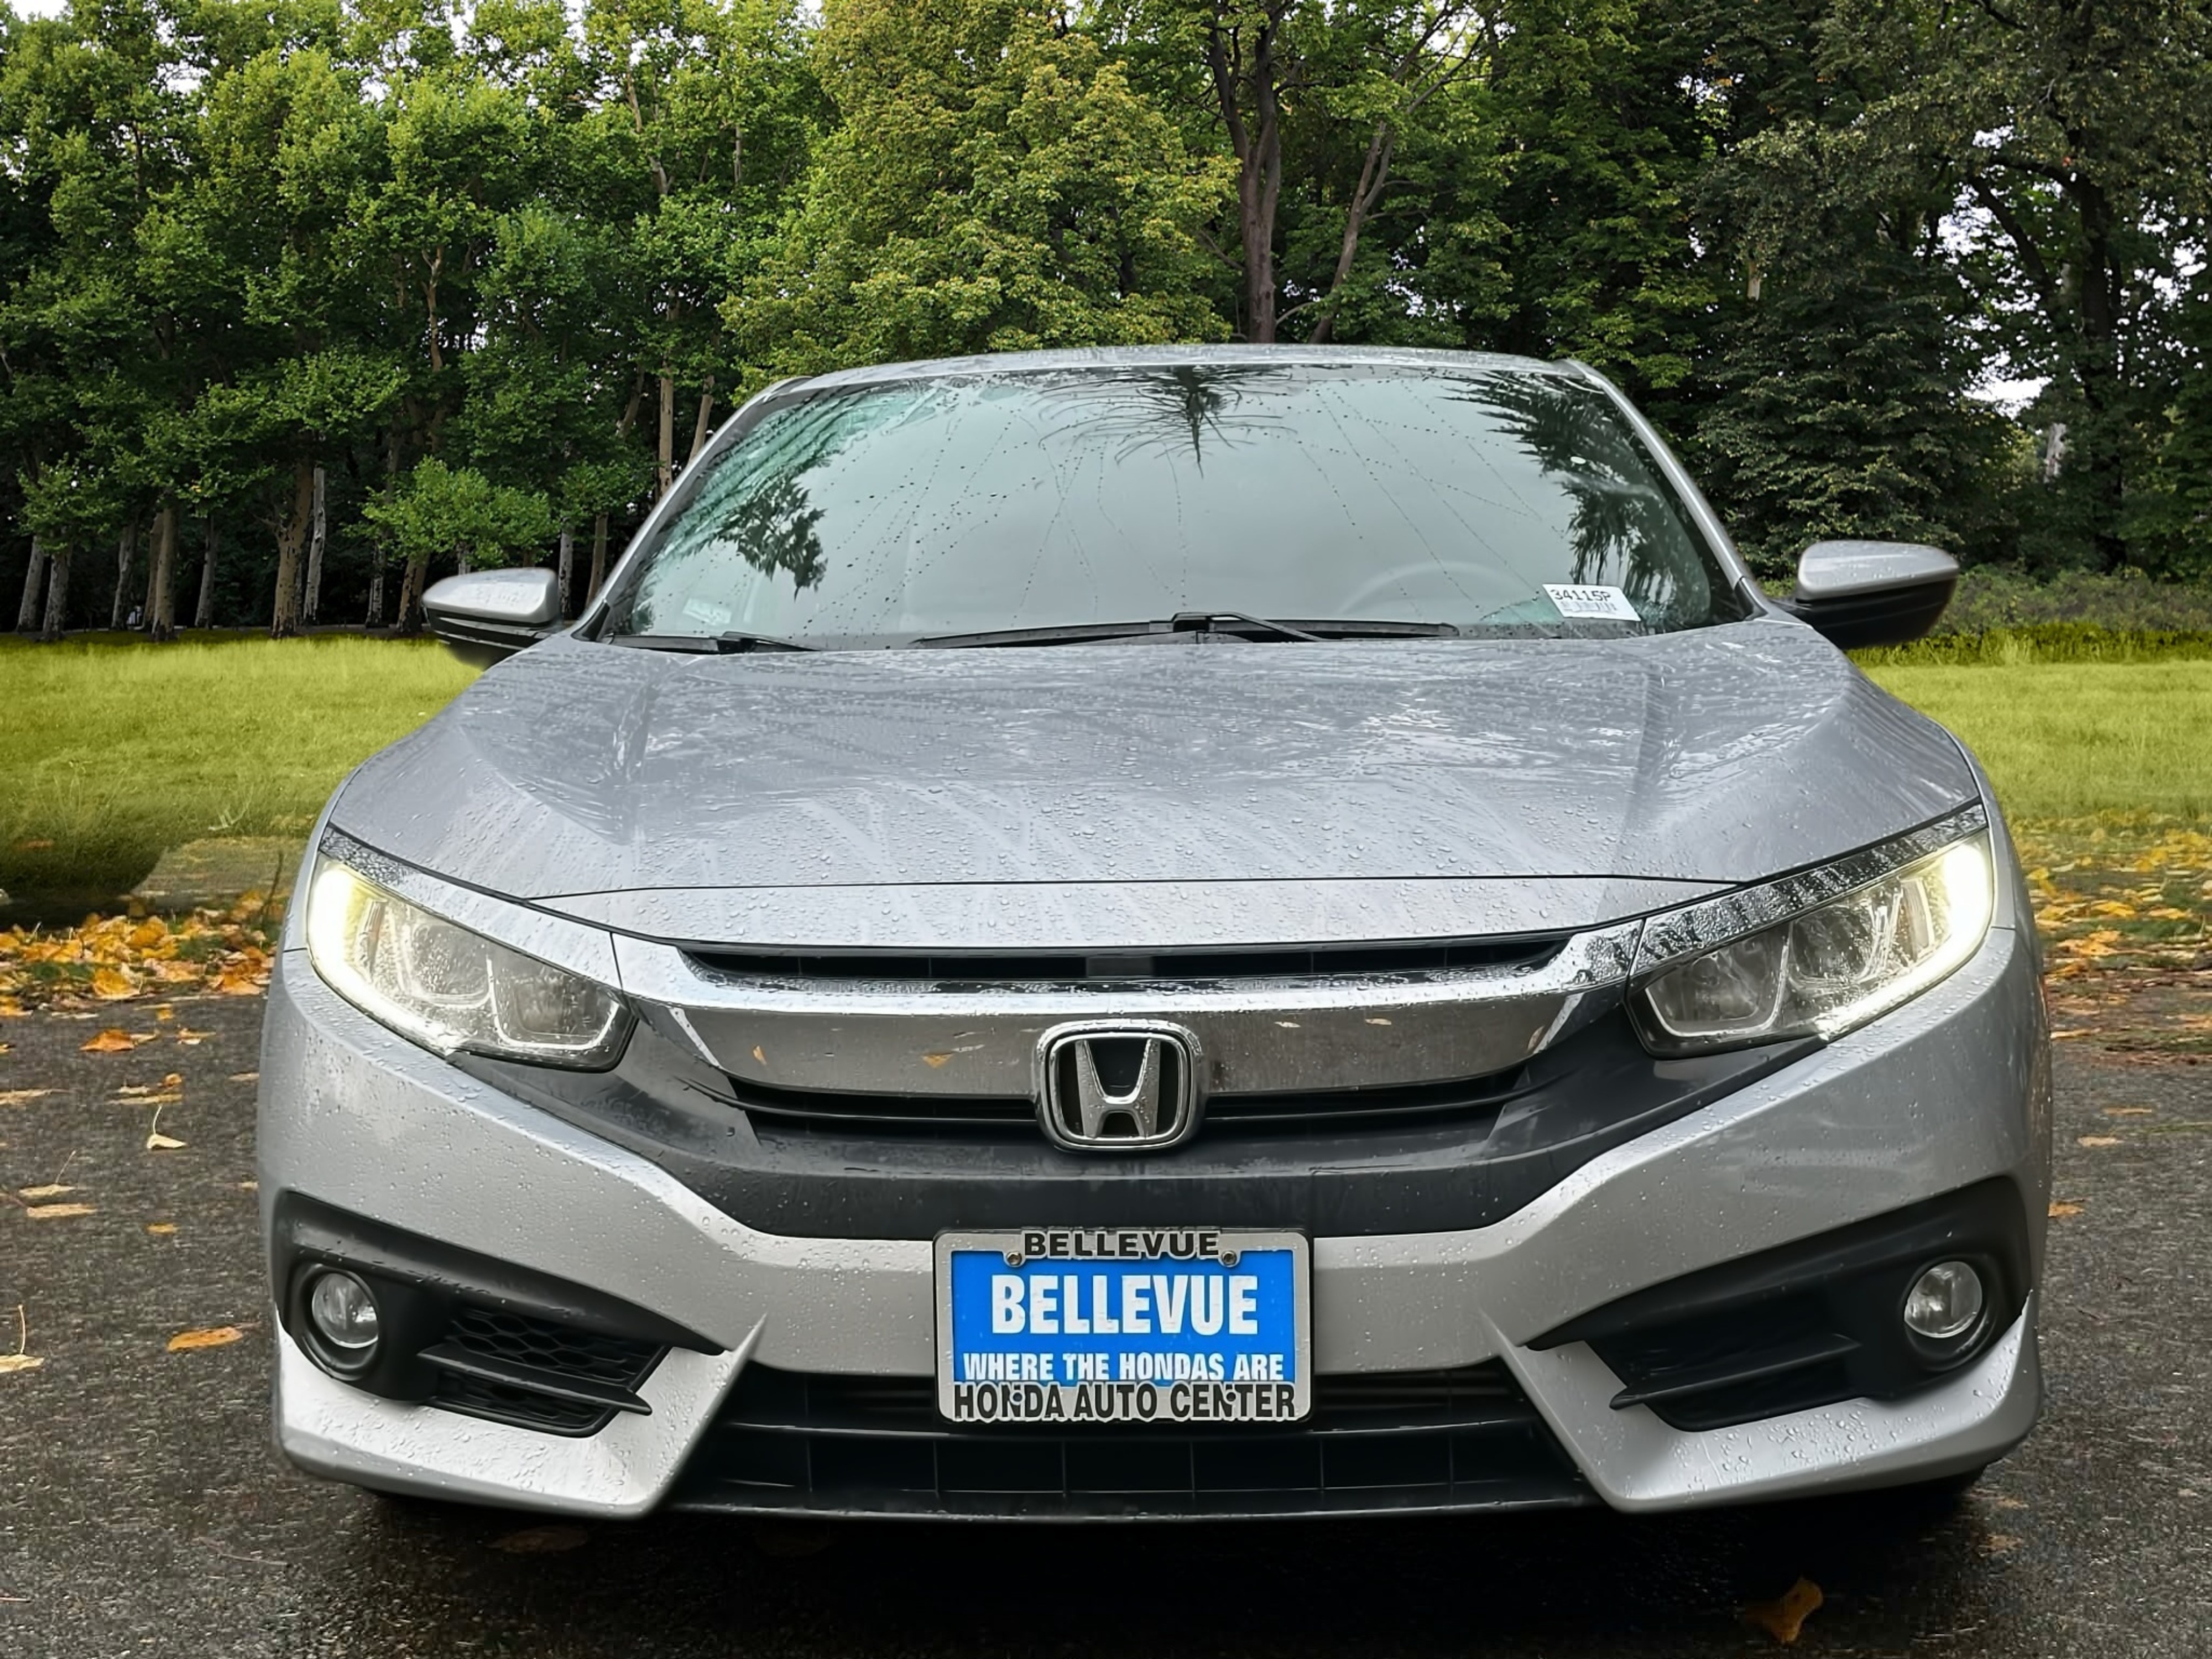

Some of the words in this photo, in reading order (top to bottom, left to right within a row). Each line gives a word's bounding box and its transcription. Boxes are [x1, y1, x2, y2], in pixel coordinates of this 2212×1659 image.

[1551, 589, 1611, 602] 34115P
[1024, 1233, 1219, 1256] BELLEVUE
[992, 1275, 1258, 1335] BELLEVUE
[963, 1353, 1053, 1380] WHERE
[1062, 1353, 1109, 1380] THE
[1119, 1352, 1225, 1380] HONDAS
[1233, 1354, 1284, 1380] ARE
[954, 1384, 1063, 1418] HONDA
[1074, 1384, 1159, 1418] AUTO
[1170, 1384, 1295, 1418] CENTER
